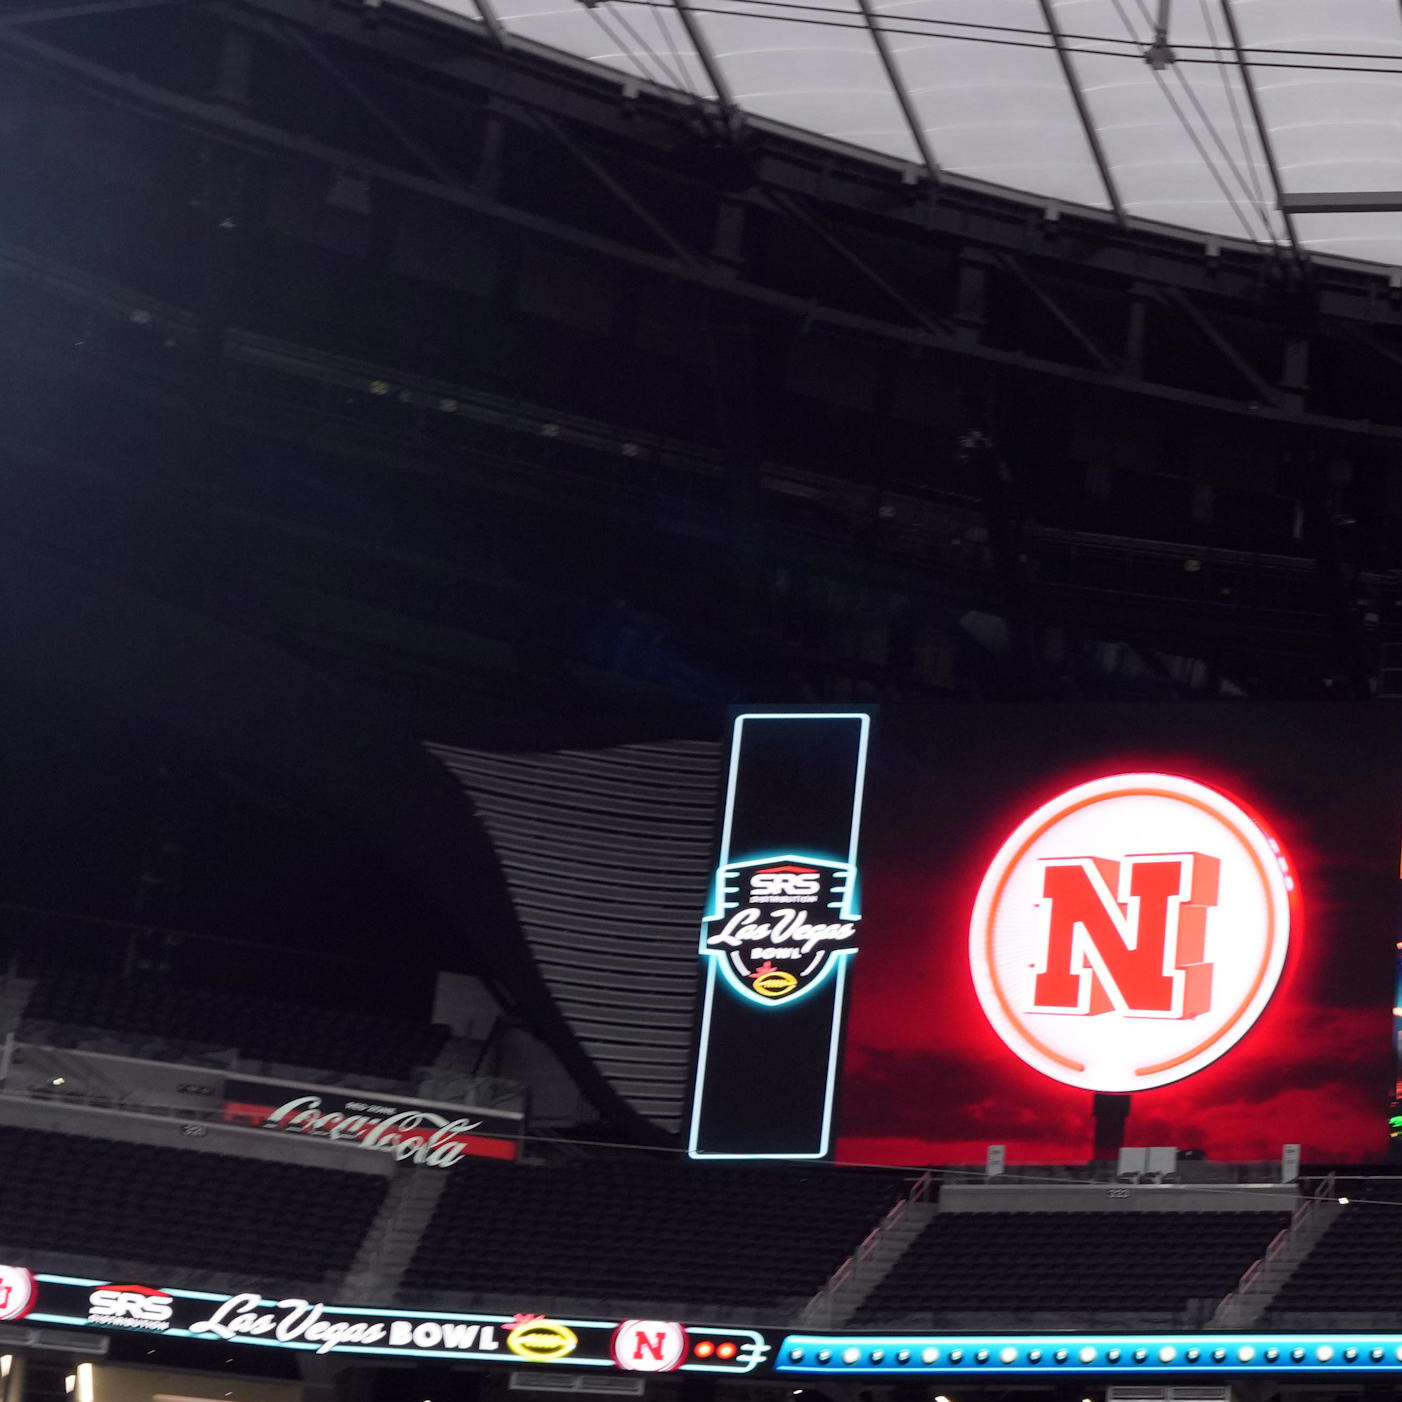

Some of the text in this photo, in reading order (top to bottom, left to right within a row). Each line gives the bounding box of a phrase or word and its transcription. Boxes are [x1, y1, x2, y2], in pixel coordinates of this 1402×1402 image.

[750, 873, 820, 895] SRS
[707, 908, 856, 953] Las Vegas
[1027, 852, 1220, 1020] N
[751, 948, 802, 959] BOWL
[89, 1290, 173, 1320] SRS
[189, 1293, 499, 1354] Las Vegas BOWL
[633, 1331, 667, 1361] N
